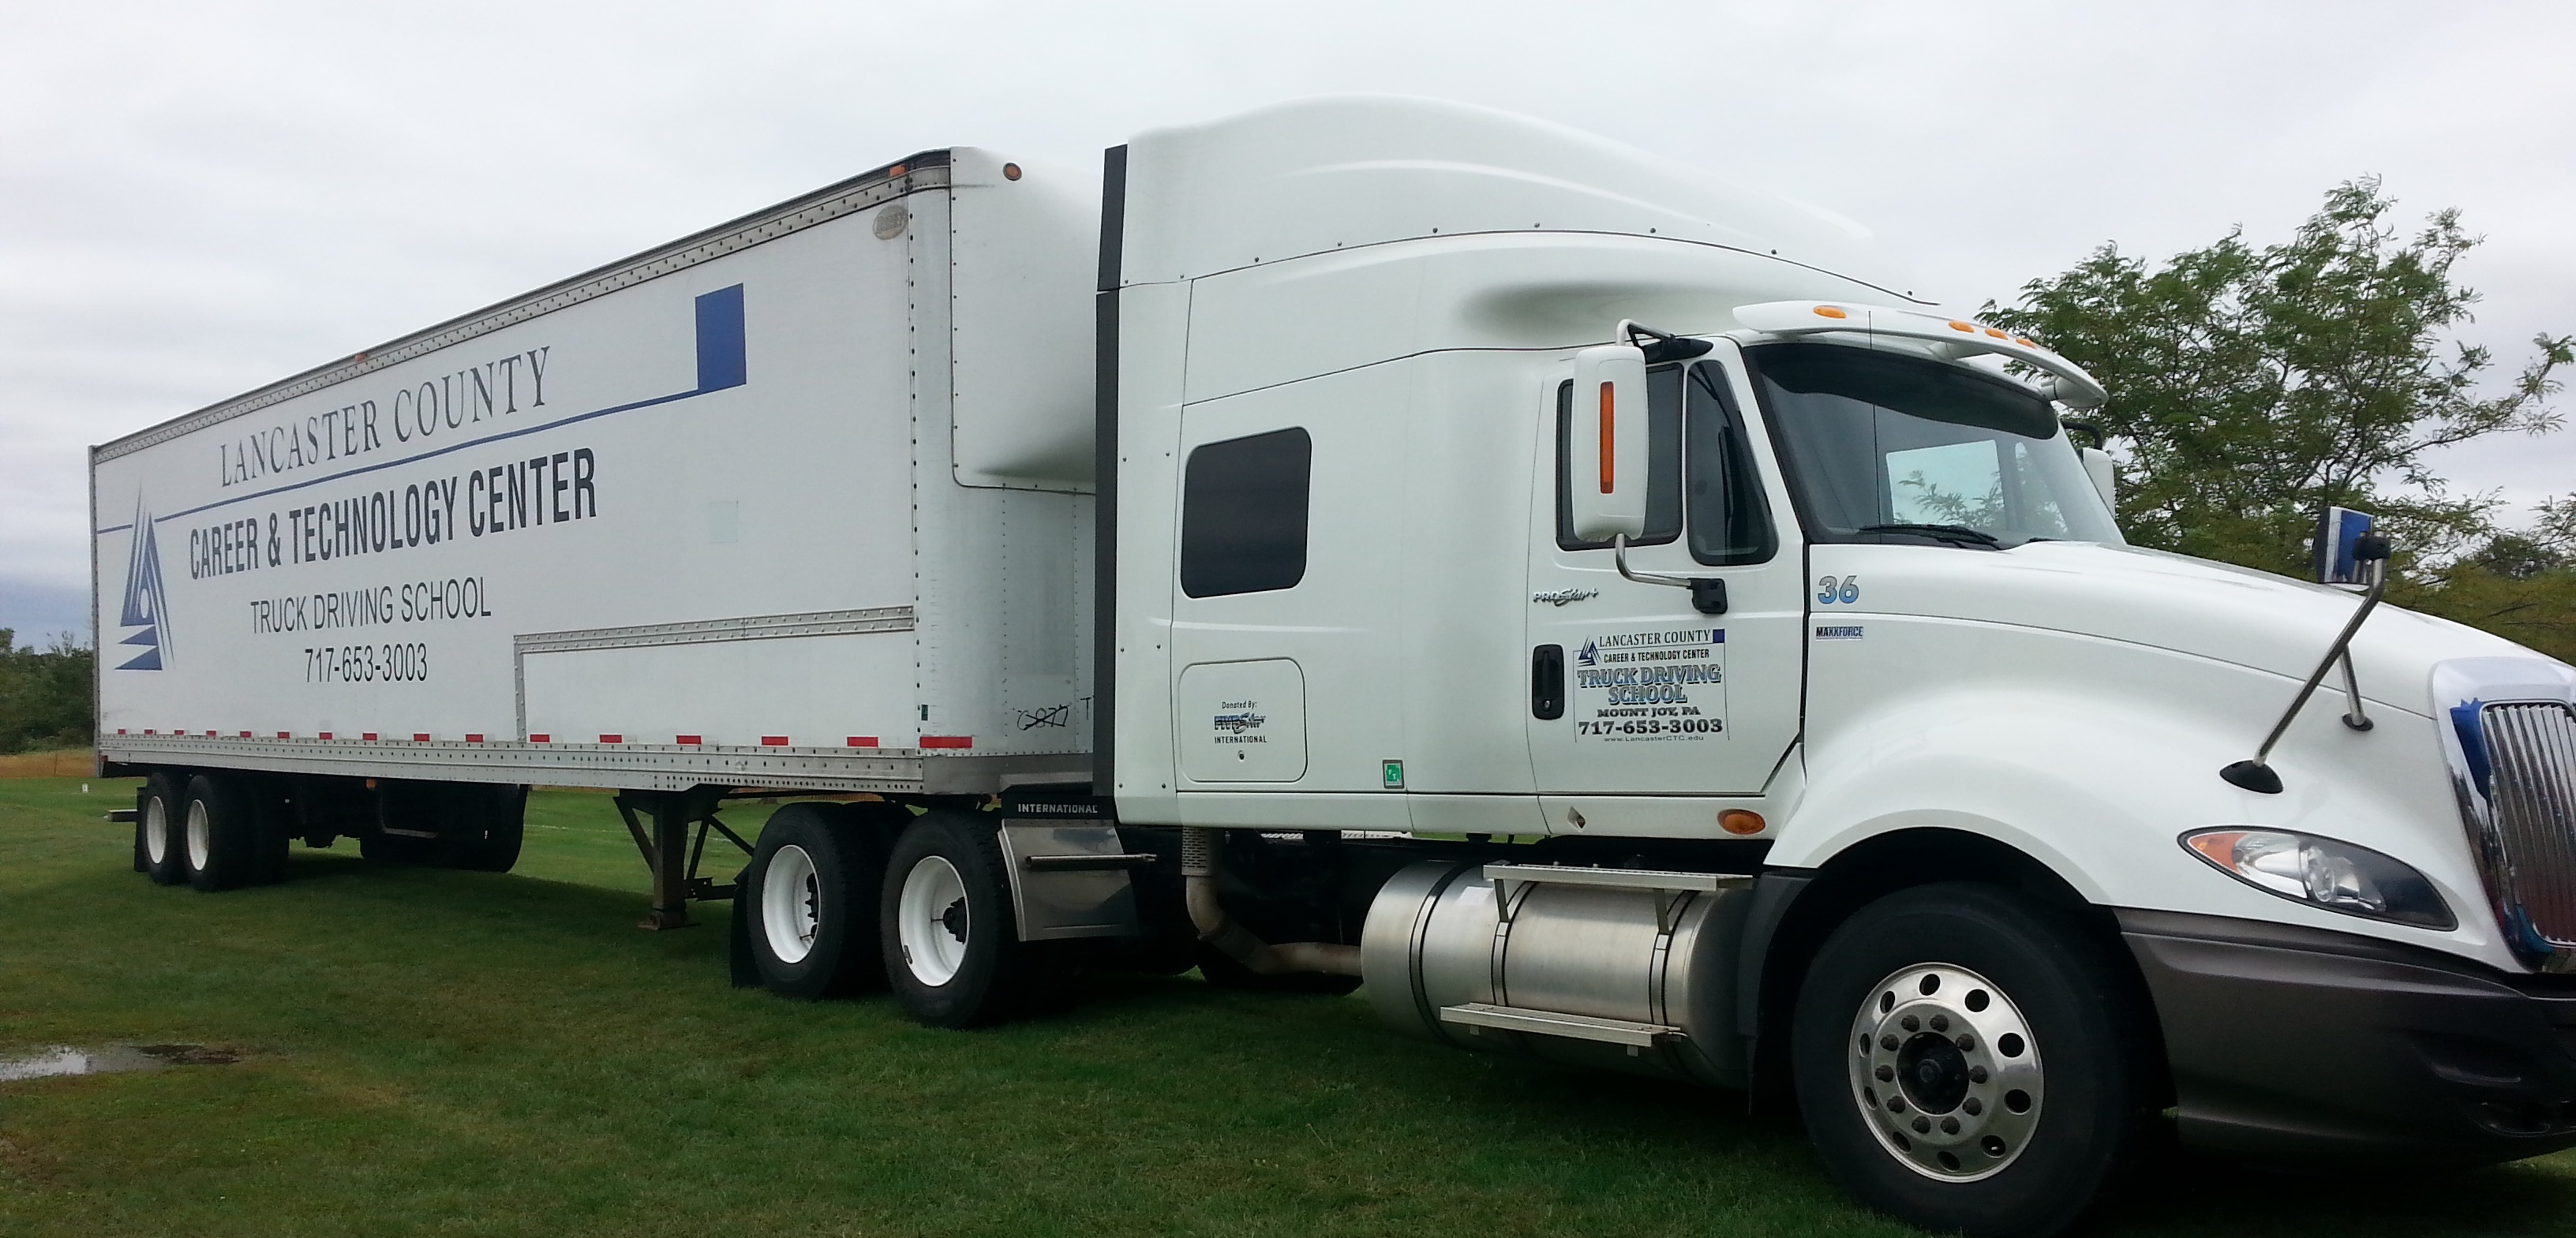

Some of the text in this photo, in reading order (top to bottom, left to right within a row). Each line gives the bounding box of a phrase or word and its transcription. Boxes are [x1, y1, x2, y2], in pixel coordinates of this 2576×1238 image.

[221, 346, 551, 487] LANCASTER COUNTY
[190, 447, 597, 580] CAREER & TECHNOLOGY CENTER
[1818, 575, 1859, 604] 36
[250, 576, 492, 634] TRUCK DRIVING SCHOOL
[1599, 629, 1711, 648] LANCASTER COUNTY
[1816, 626, 1863, 637] MAXXFORCE
[305, 642, 428, 683] 717-653-3003
[1604, 649, 1710, 664] CAREER & TECHNOLOGY CENTER
[1577, 664, 1722, 689] TRUCK DRIVING
[1608, 684, 1688, 706] SCHOOL
[1222, 701, 1247, 709] Donated
[1597, 708, 1649, 718] MOUNT
[1682, 706, 1702, 716] PA
[1578, 718, 1724, 735] 717-653-3003
[1214, 735, 1267, 744] INTERNATIONAL
[1017, 803, 1099, 813] INTERNATIONAL
